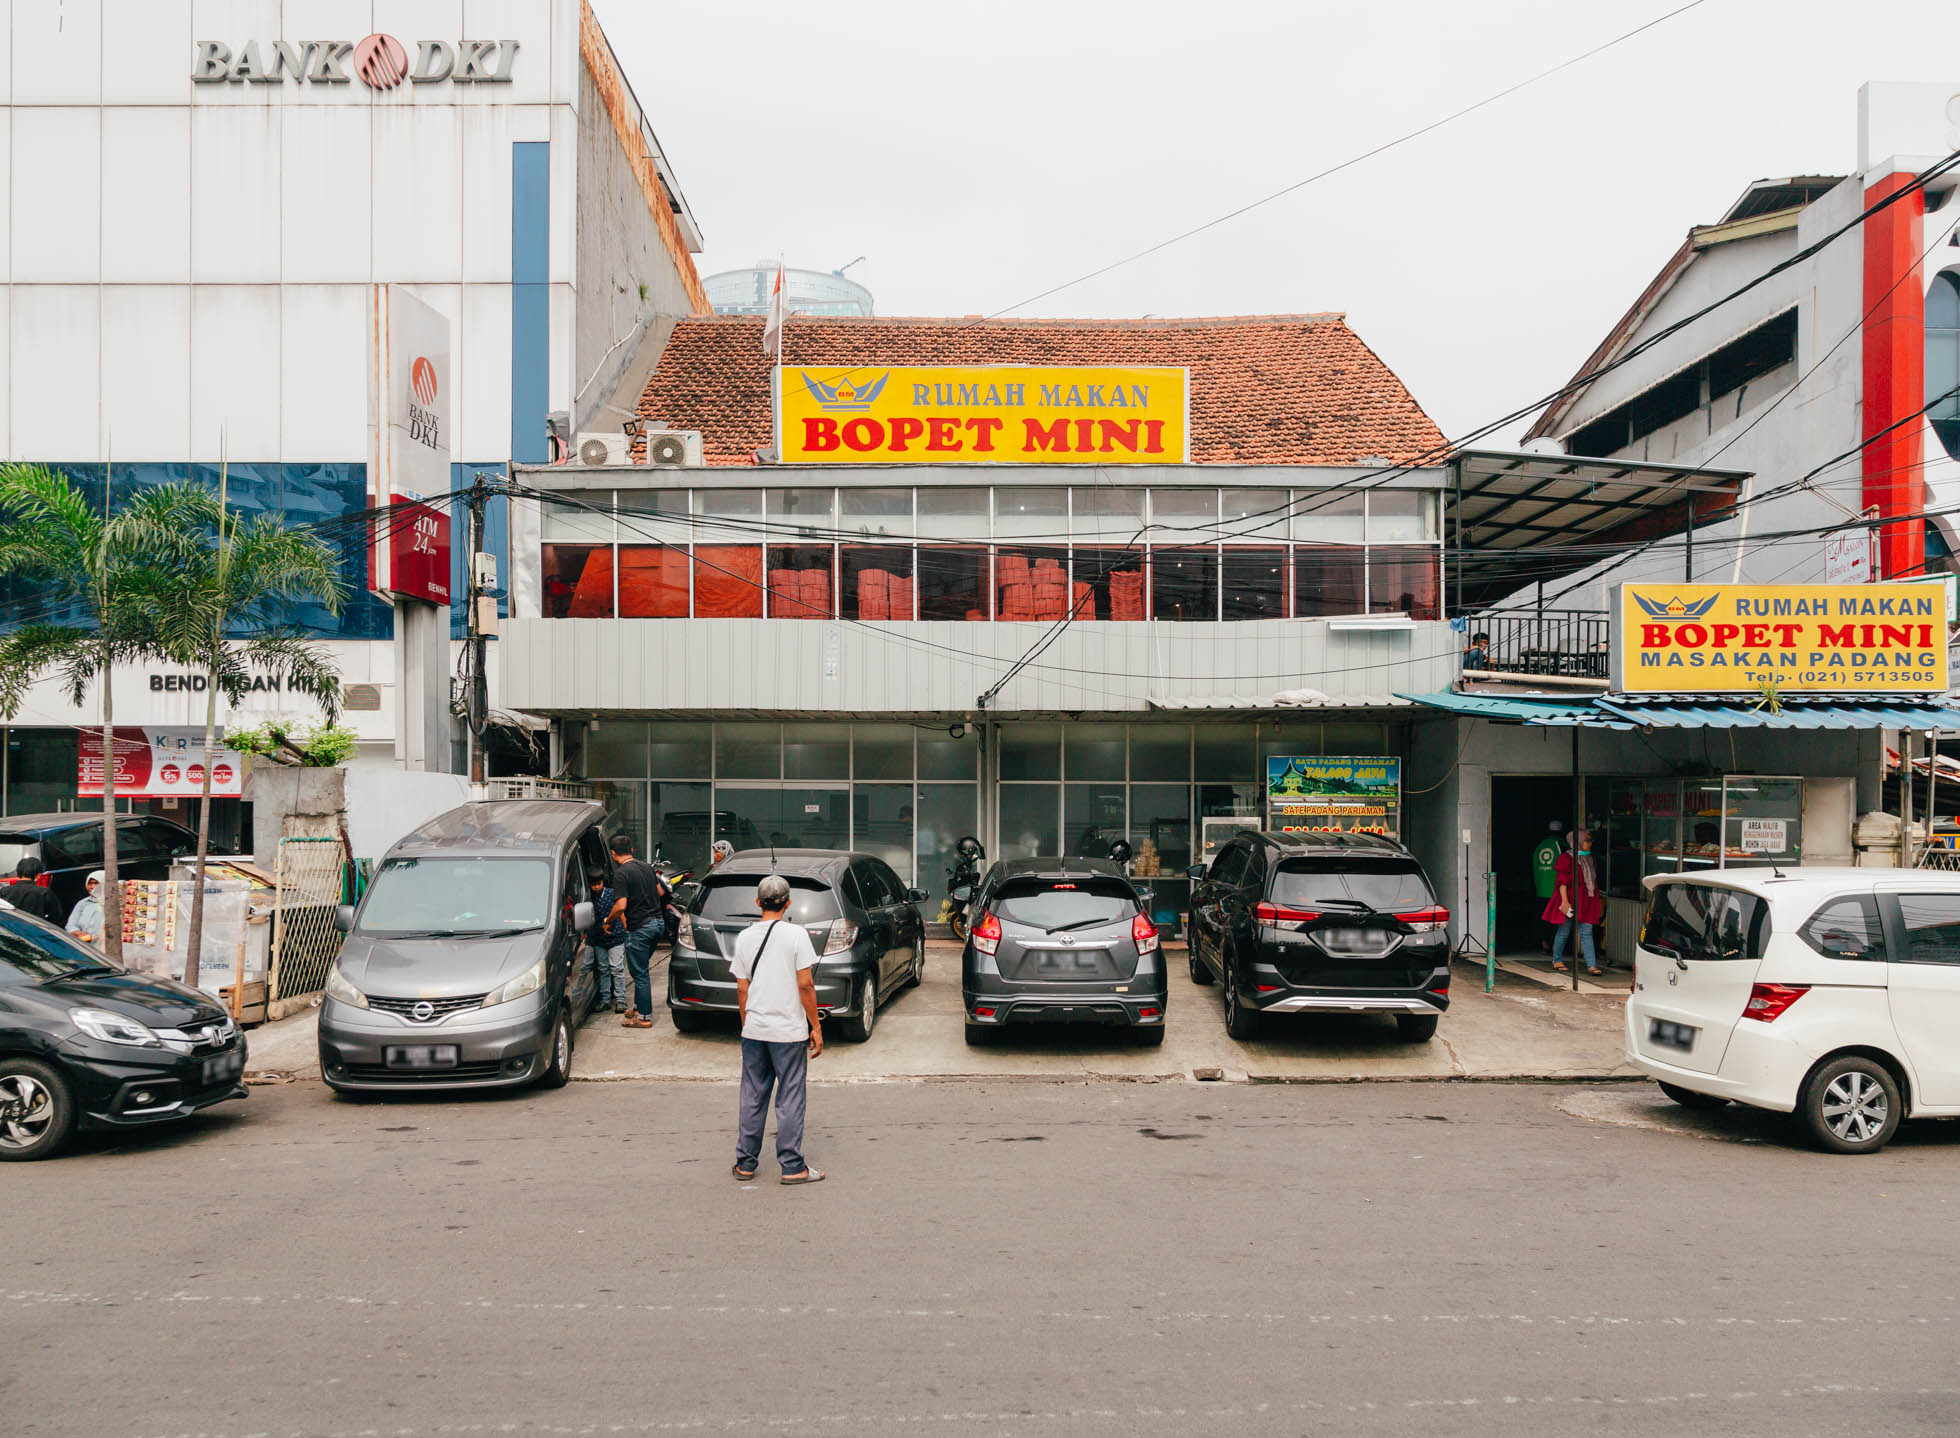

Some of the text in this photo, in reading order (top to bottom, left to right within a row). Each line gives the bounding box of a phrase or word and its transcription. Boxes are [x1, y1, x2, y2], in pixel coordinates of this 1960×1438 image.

[191, 40, 520, 84] BANK DKI
[912, 383, 1150, 407] RUMAH MAKAN
[409, 403, 439, 430] BANK
[409, 418, 439, 450] DKI
[801, 417, 1164, 453] BOPET MINI
[413, 515, 438, 538] ATM
[413, 532, 428, 554] 24
[427, 581, 448, 597] BENHIL
[1735, 598, 1828, 616] RUMAH
[1839, 598, 1932, 616] MAKAN
[1640, 623, 1934, 649] BOPET MINI
[1641, 652, 1797, 667] MASAKAN
[1810, 652, 1936, 667] PADANG
[1798, 671, 1846, 684] (021)
[1853, 671, 1935, 682] 5713505
[1305, 767, 1386, 779] TALAGO JAYA
[1685, 791, 1712, 809] MINI
[1283, 806, 1385, 815] SATE PADANG PARIAMAN
[1748, 821, 1761, 830] AREA
